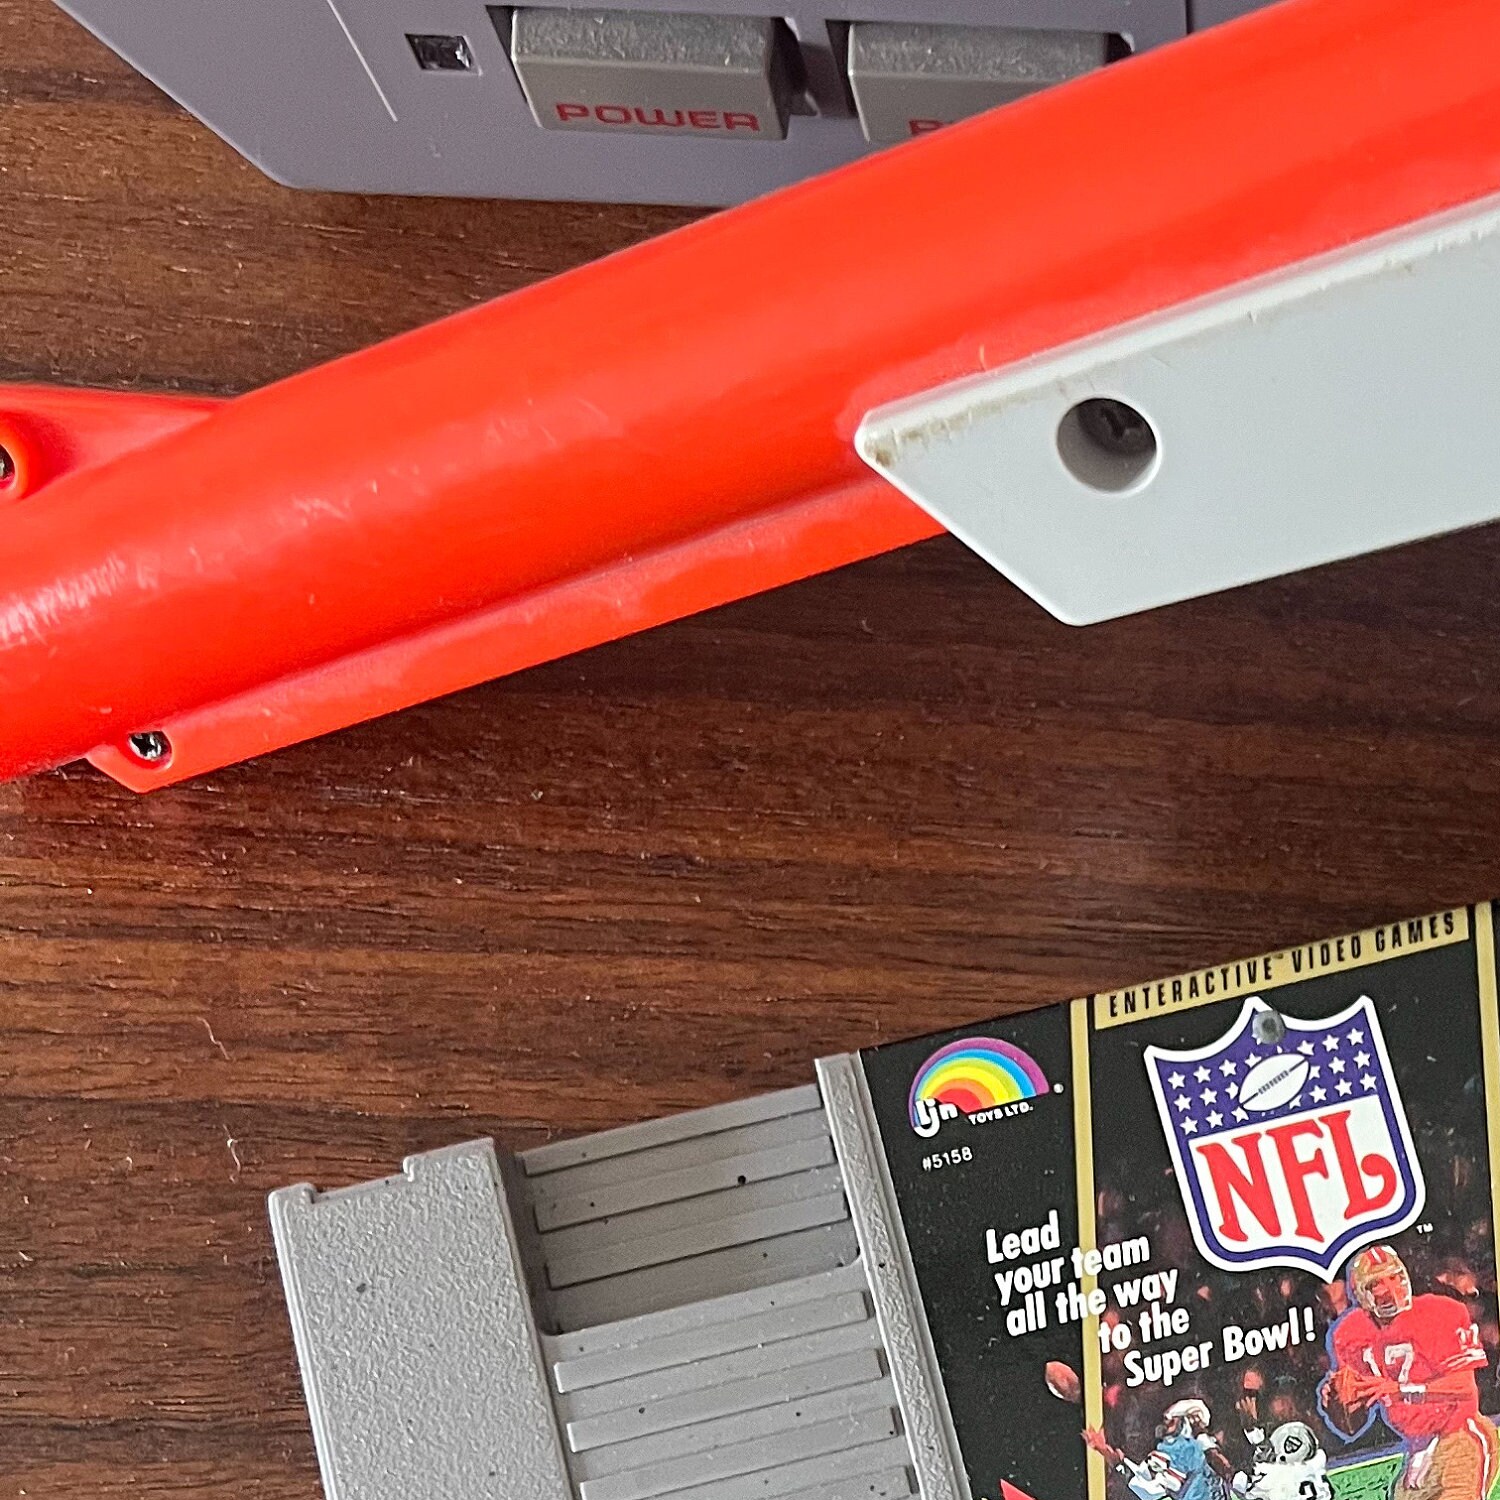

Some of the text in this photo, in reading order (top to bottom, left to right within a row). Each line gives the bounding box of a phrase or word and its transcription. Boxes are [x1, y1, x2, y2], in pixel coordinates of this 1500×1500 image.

[555, 102, 761, 132] POWER
[1292, 934, 1363, 974] VIDEO
[1375, 911, 1456, 953] GAMES
[922, 1146, 973, 1172] #5158
[1196, 1110, 1397, 1243] NFL
[985, 1209, 1060, 1264] Lead
[994, 1236, 1150, 1307] your team
[1006, 1269, 1179, 1337] all the way
[1098, 1301, 1191, 1354] to the
[1123, 1306, 1316, 1387] Super Bowl!
